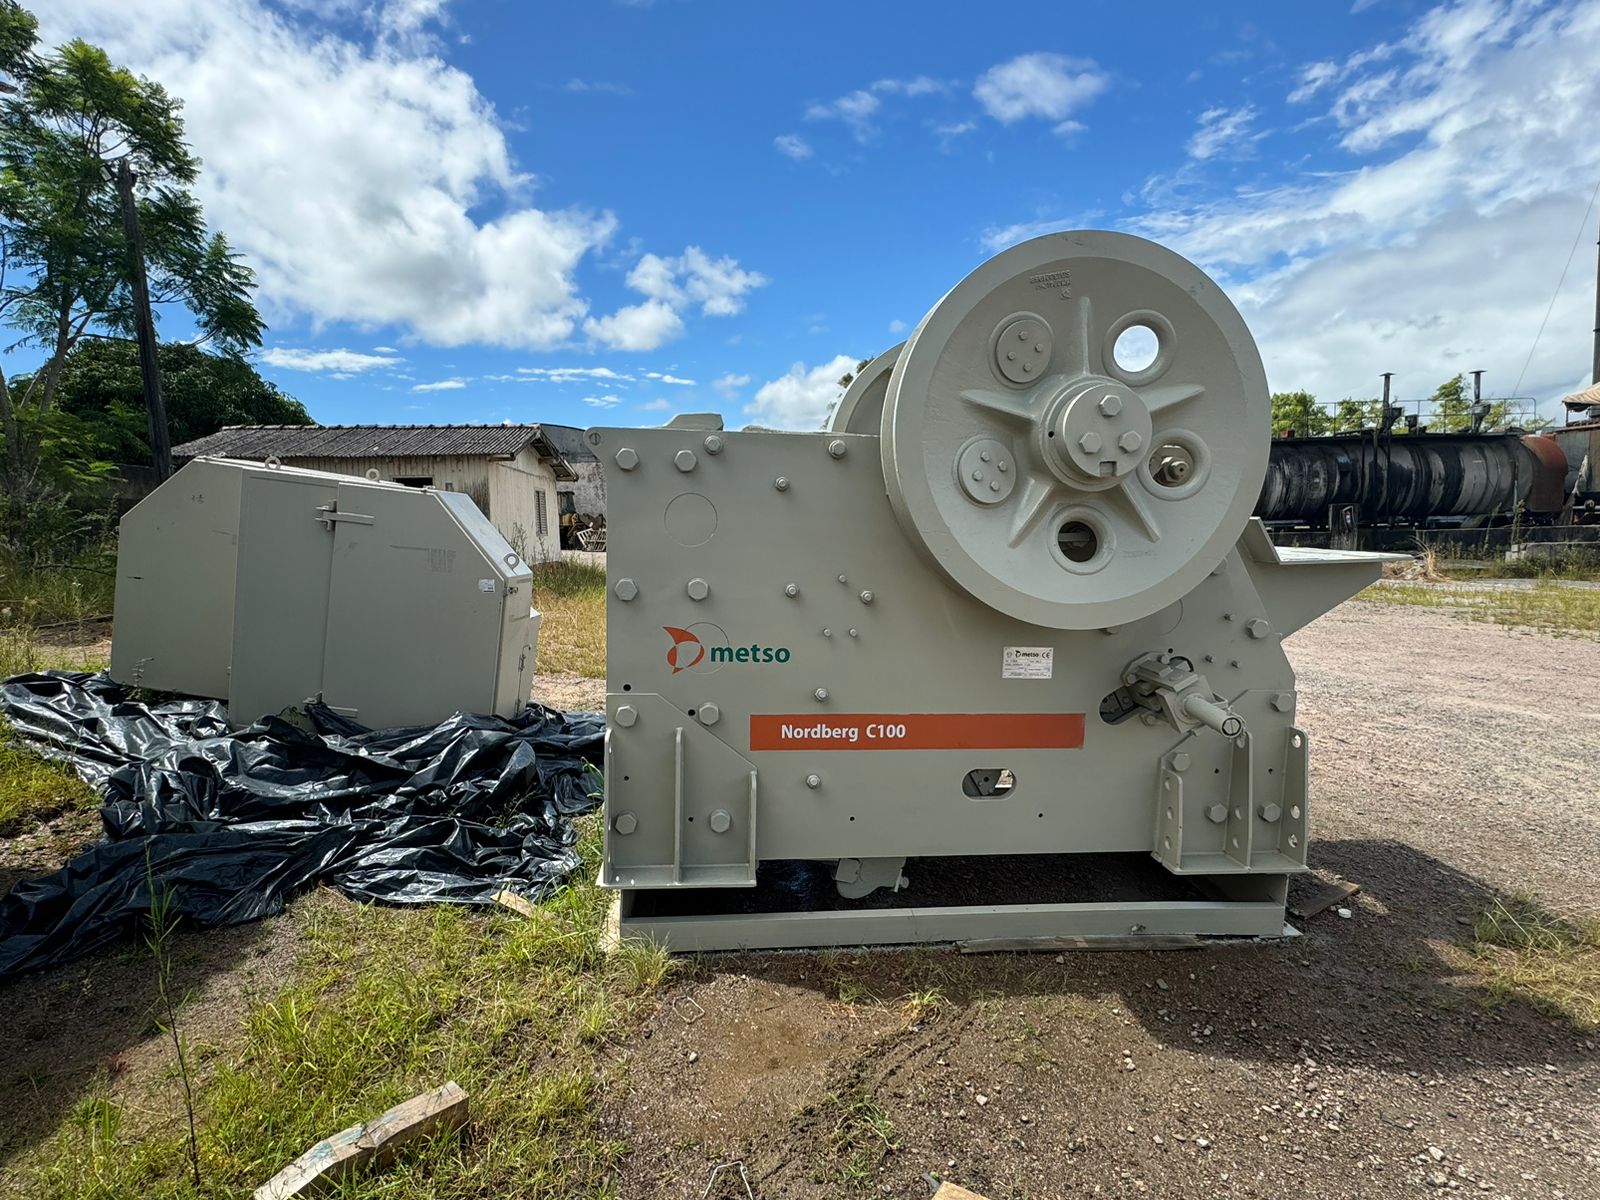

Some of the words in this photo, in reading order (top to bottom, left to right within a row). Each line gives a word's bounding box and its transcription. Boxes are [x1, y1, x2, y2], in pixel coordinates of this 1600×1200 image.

[711, 644, 791, 663] metso
[781, 723, 859, 742] Nordberg
[866, 724, 906, 739] C100
